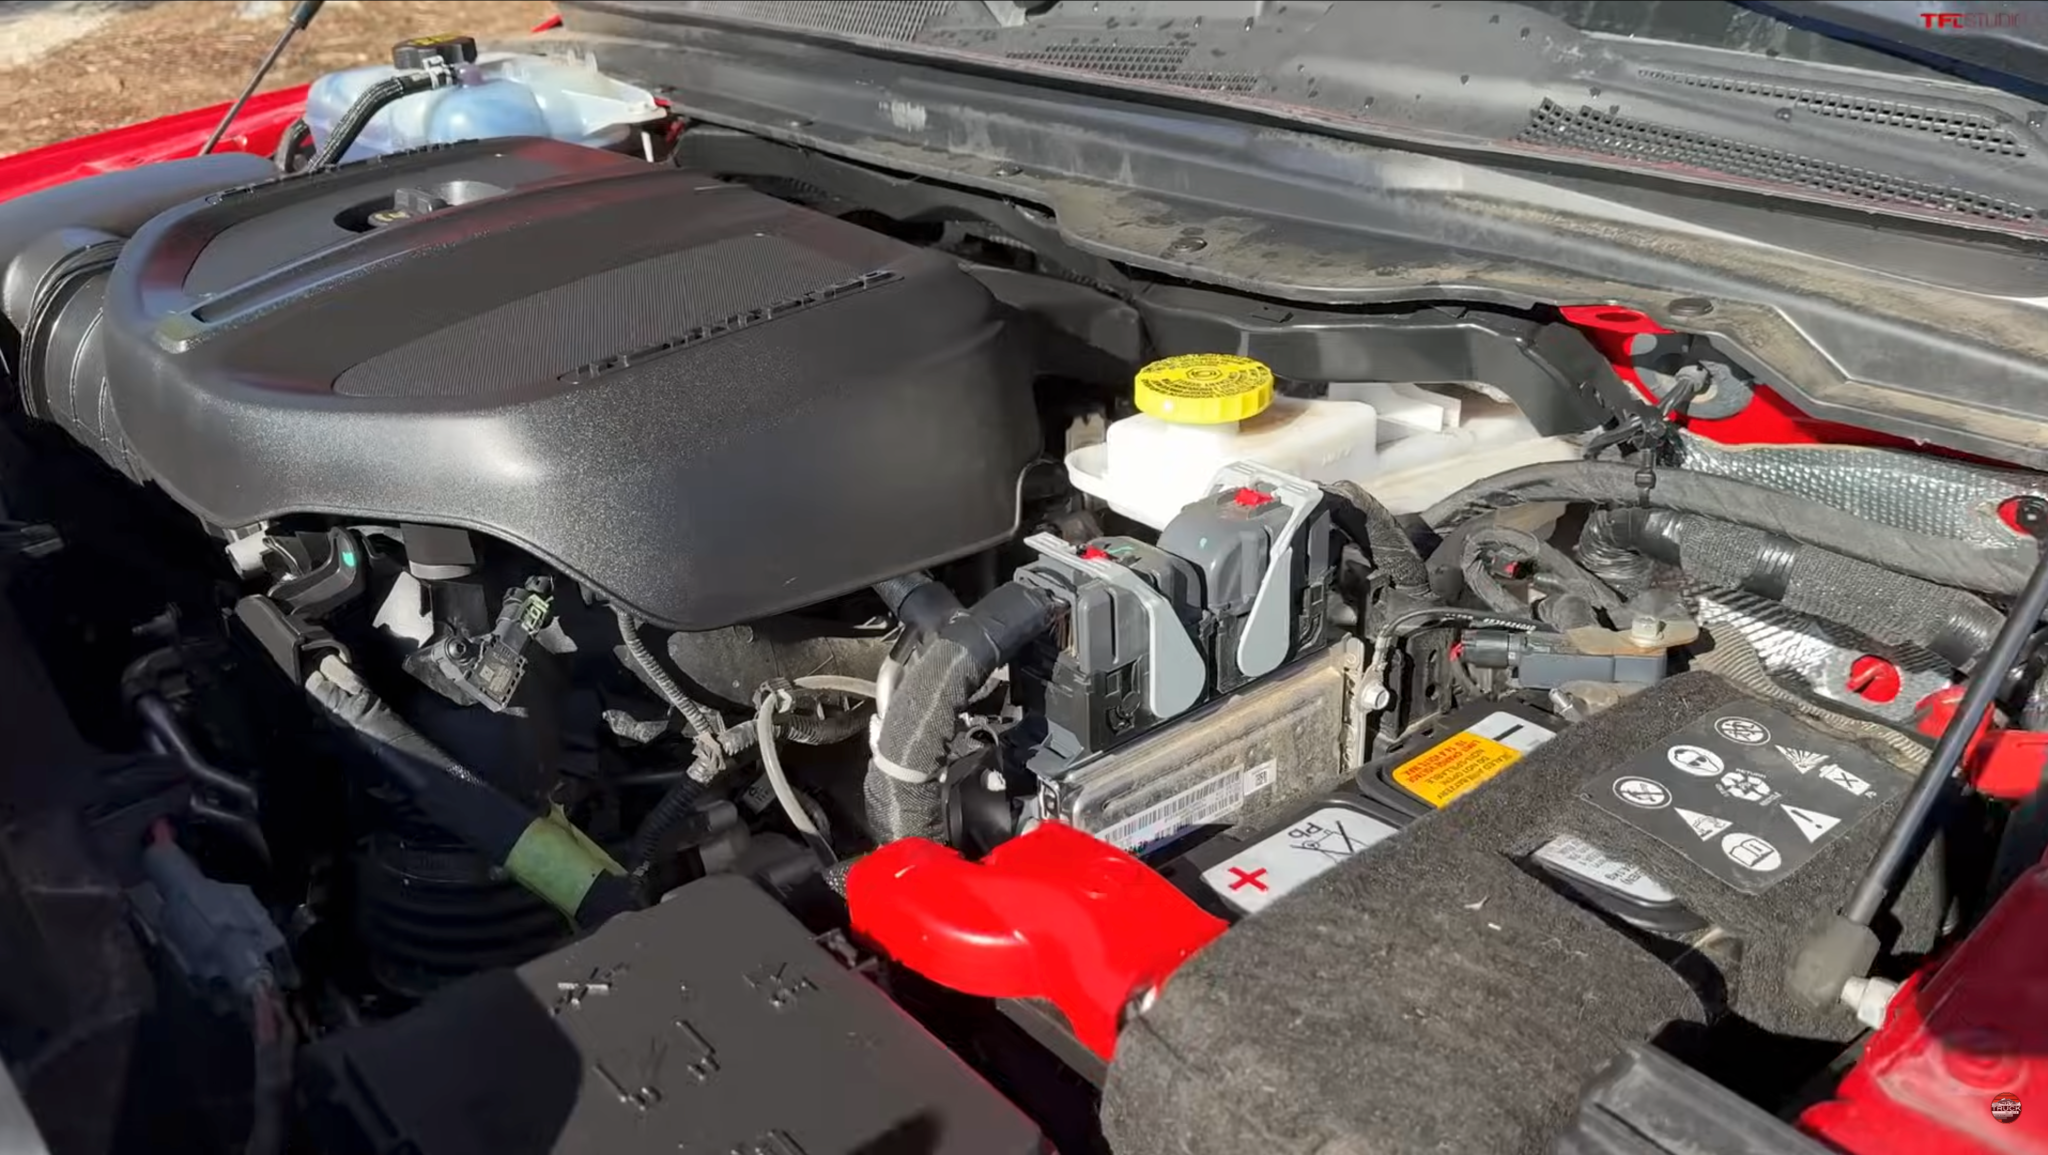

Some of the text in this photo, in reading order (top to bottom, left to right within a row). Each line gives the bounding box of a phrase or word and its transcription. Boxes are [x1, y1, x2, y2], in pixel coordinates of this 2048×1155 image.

[1476, 756, 1490, 765] DO
[1462, 762, 1479, 774] NOT
[1288, 822, 1323, 838] Pb
